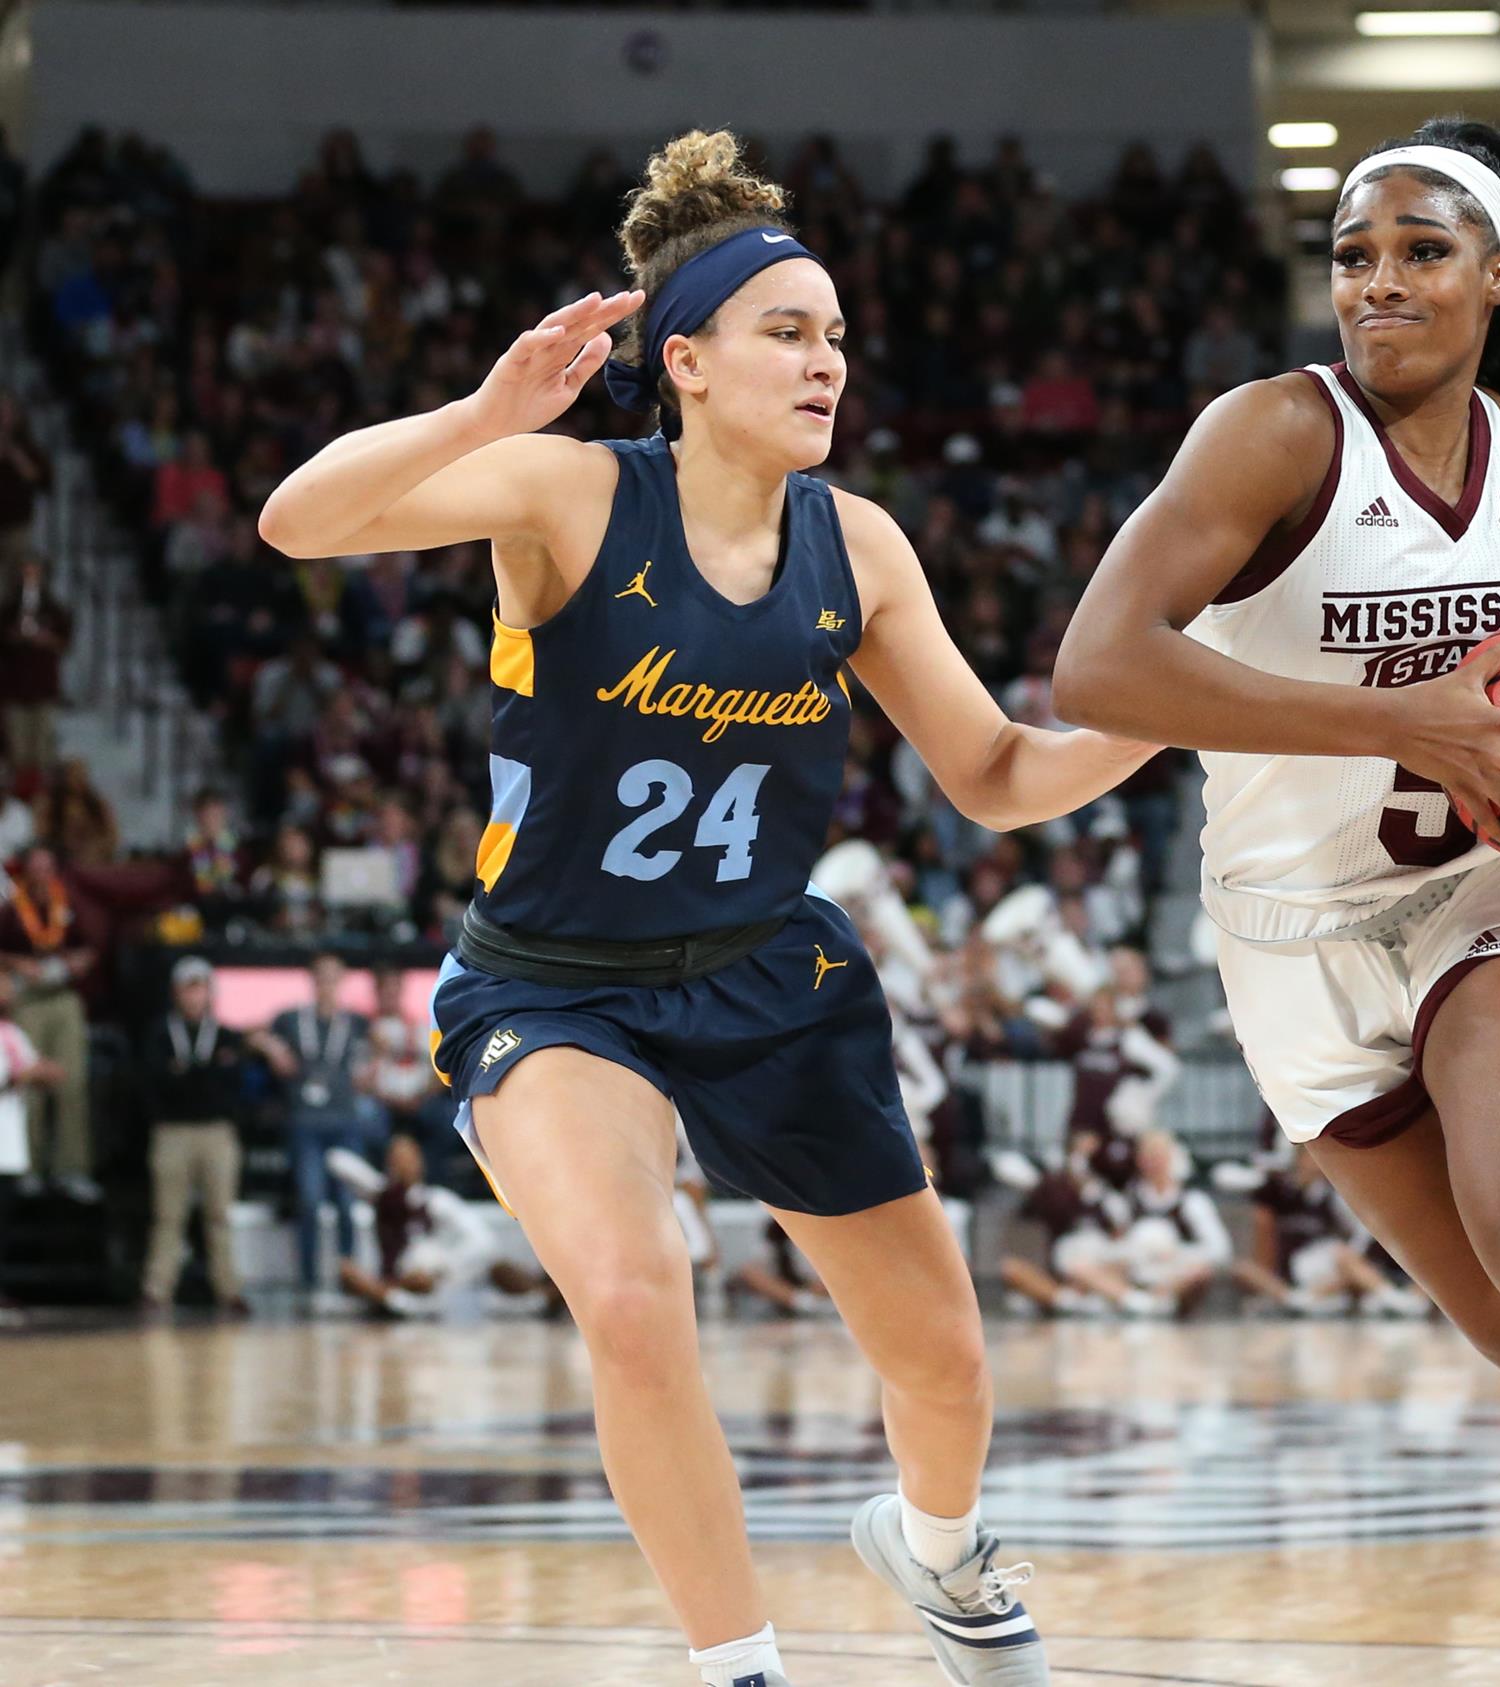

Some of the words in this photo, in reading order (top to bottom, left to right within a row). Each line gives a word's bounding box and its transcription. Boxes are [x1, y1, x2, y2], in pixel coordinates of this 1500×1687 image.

[1355, 515, 1399, 528] adidas
[596, 645, 831, 743] Marquette
[1391, 645, 1472, 685] STA
[601, 759, 772, 883] 24
